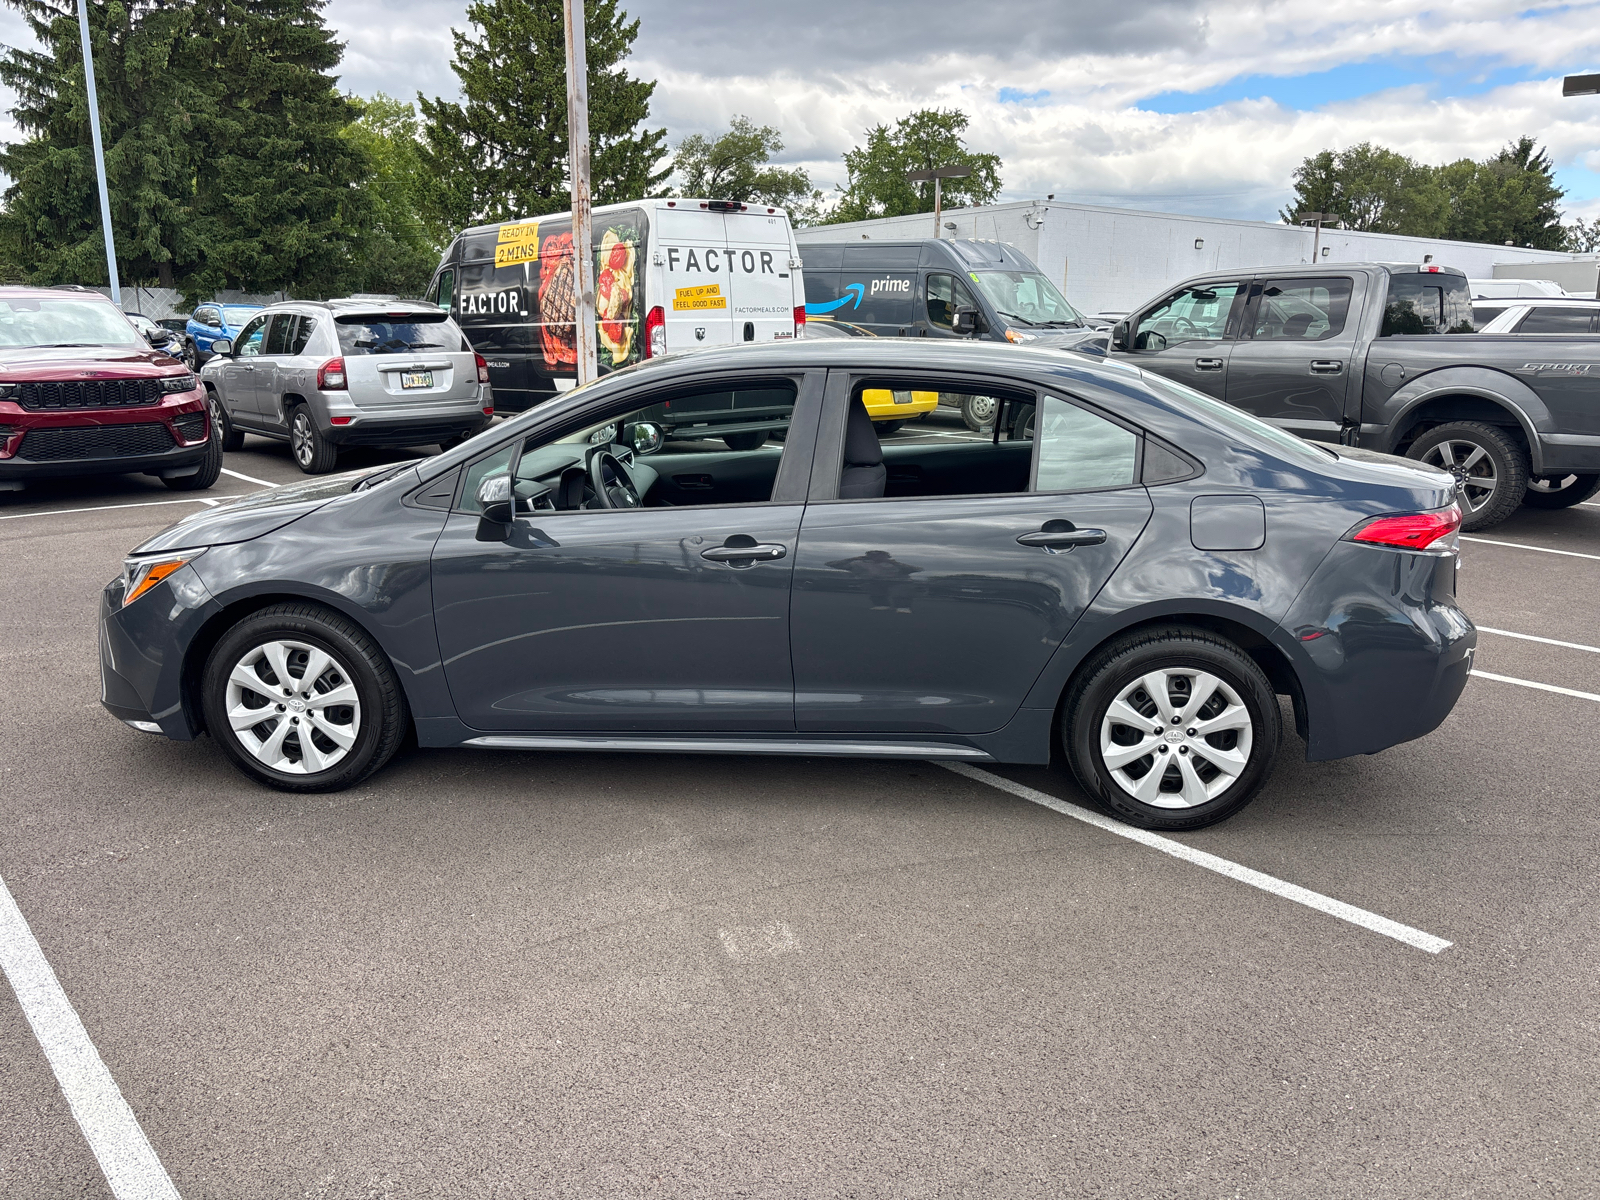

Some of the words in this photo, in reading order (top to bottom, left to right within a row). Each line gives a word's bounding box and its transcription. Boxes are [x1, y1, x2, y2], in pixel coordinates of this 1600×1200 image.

[501, 228, 525, 239] READY
[525, 226, 535, 236] IN
[499, 249, 505, 262] 2
[507, 243, 534, 261] MINS
[871, 275, 910, 295] prime
[696, 288, 704, 296] UP
[706, 286, 718, 294] AND
[692, 300, 708, 308] GOOD
[710, 299, 724, 307] FAST
[1515, 362, 1600, 372] SPORT
